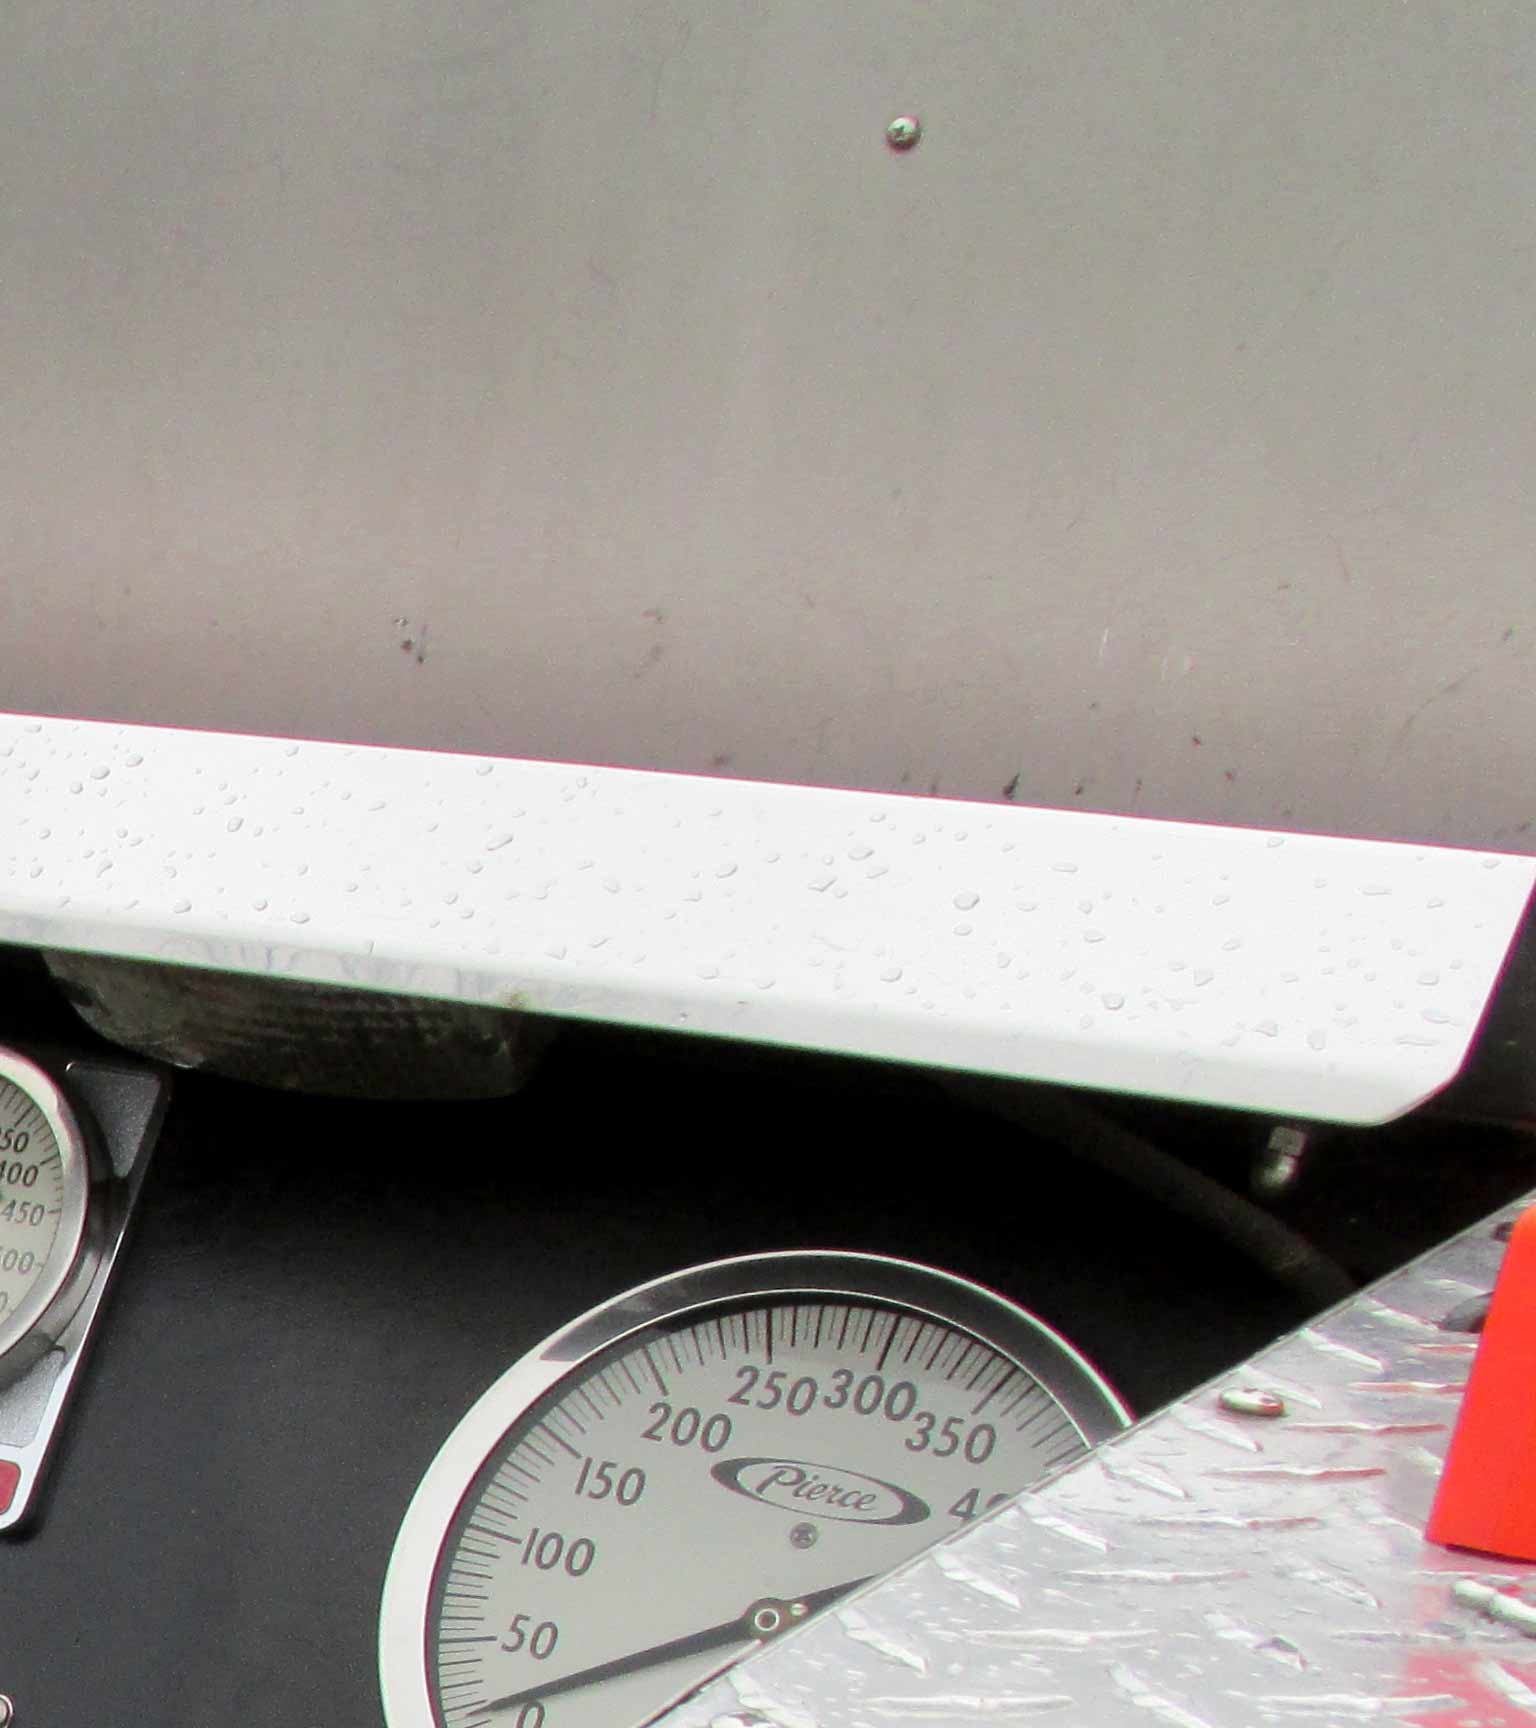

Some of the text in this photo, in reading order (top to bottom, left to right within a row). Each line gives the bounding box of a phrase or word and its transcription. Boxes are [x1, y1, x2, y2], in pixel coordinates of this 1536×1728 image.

[0, 1200, 46, 1227] 450
[727, 1364, 819, 1417] 250
[822, 1368, 919, 1422] 300
[640, 1401, 733, 1454] 200
[902, 1410, 998, 1465] 350
[573, 1455, 647, 1509] 150
[519, 1525, 598, 1578] 100
[500, 1613, 560, 1660] 50
